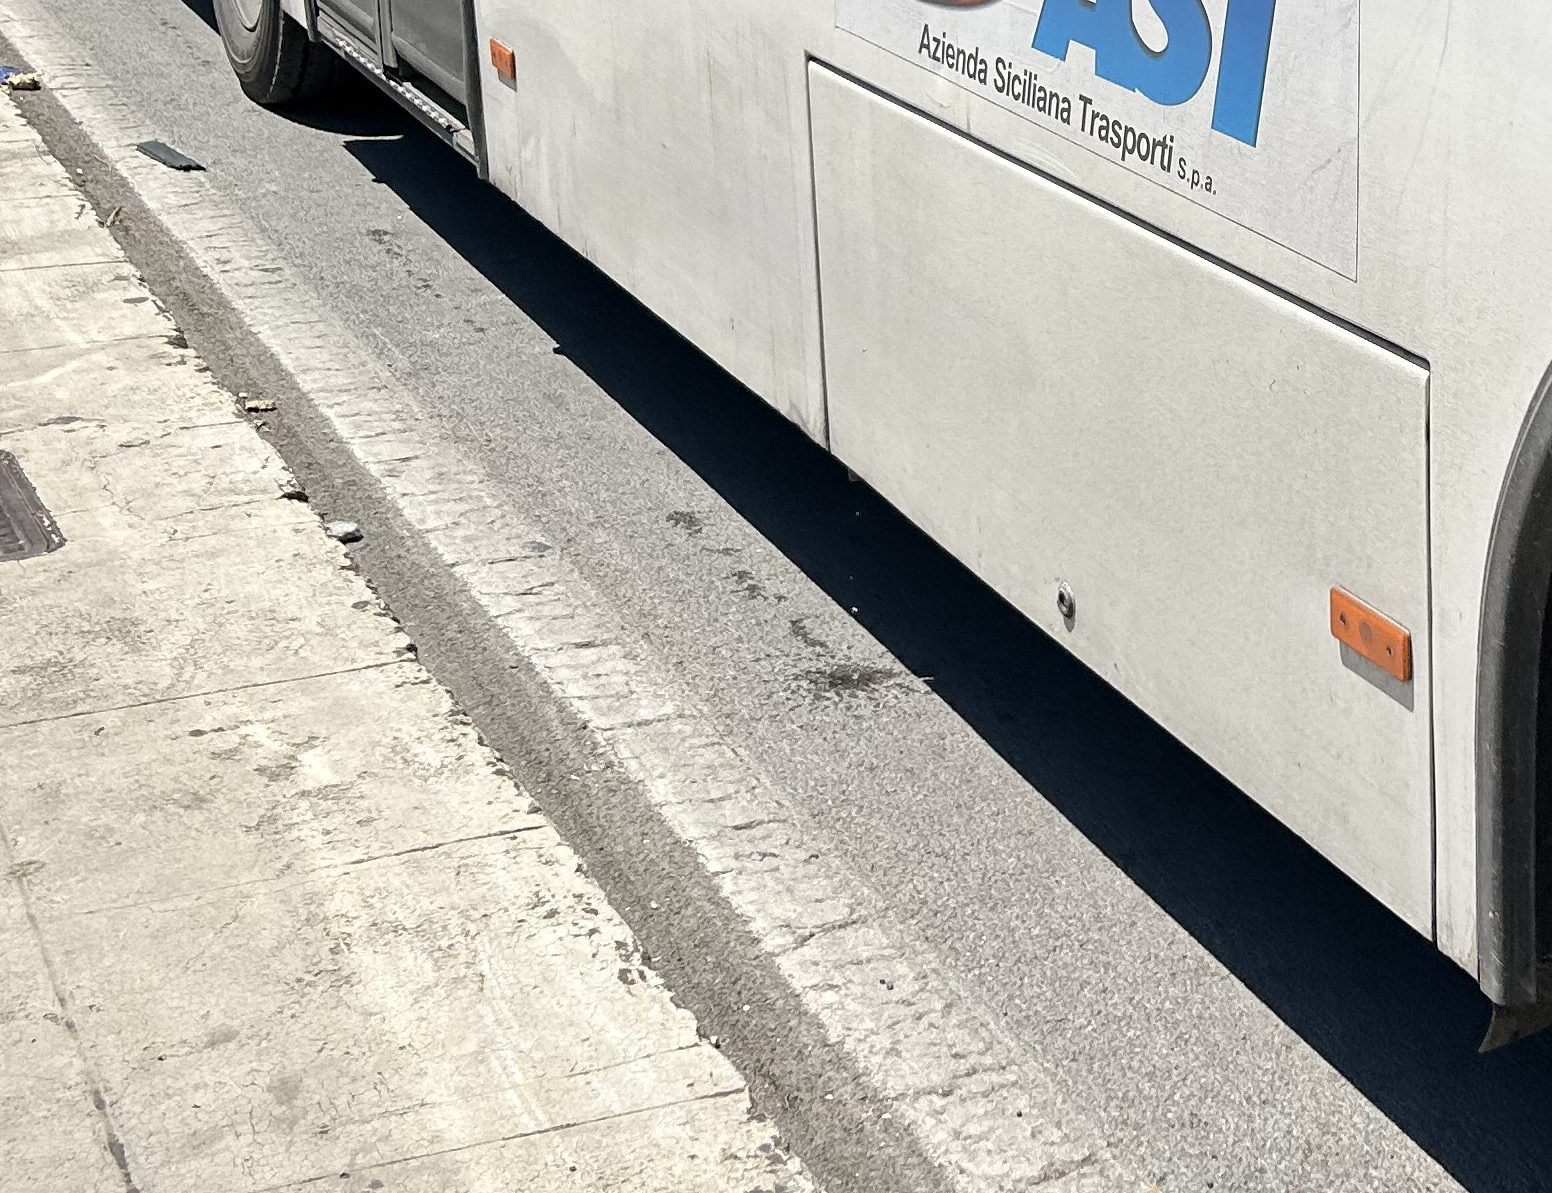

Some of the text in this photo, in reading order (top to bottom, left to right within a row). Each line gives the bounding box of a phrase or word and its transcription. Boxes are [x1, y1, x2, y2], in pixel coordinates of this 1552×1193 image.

[918, 22, 1217, 196] Azienda Siciliana Trasporti s.p.a.
